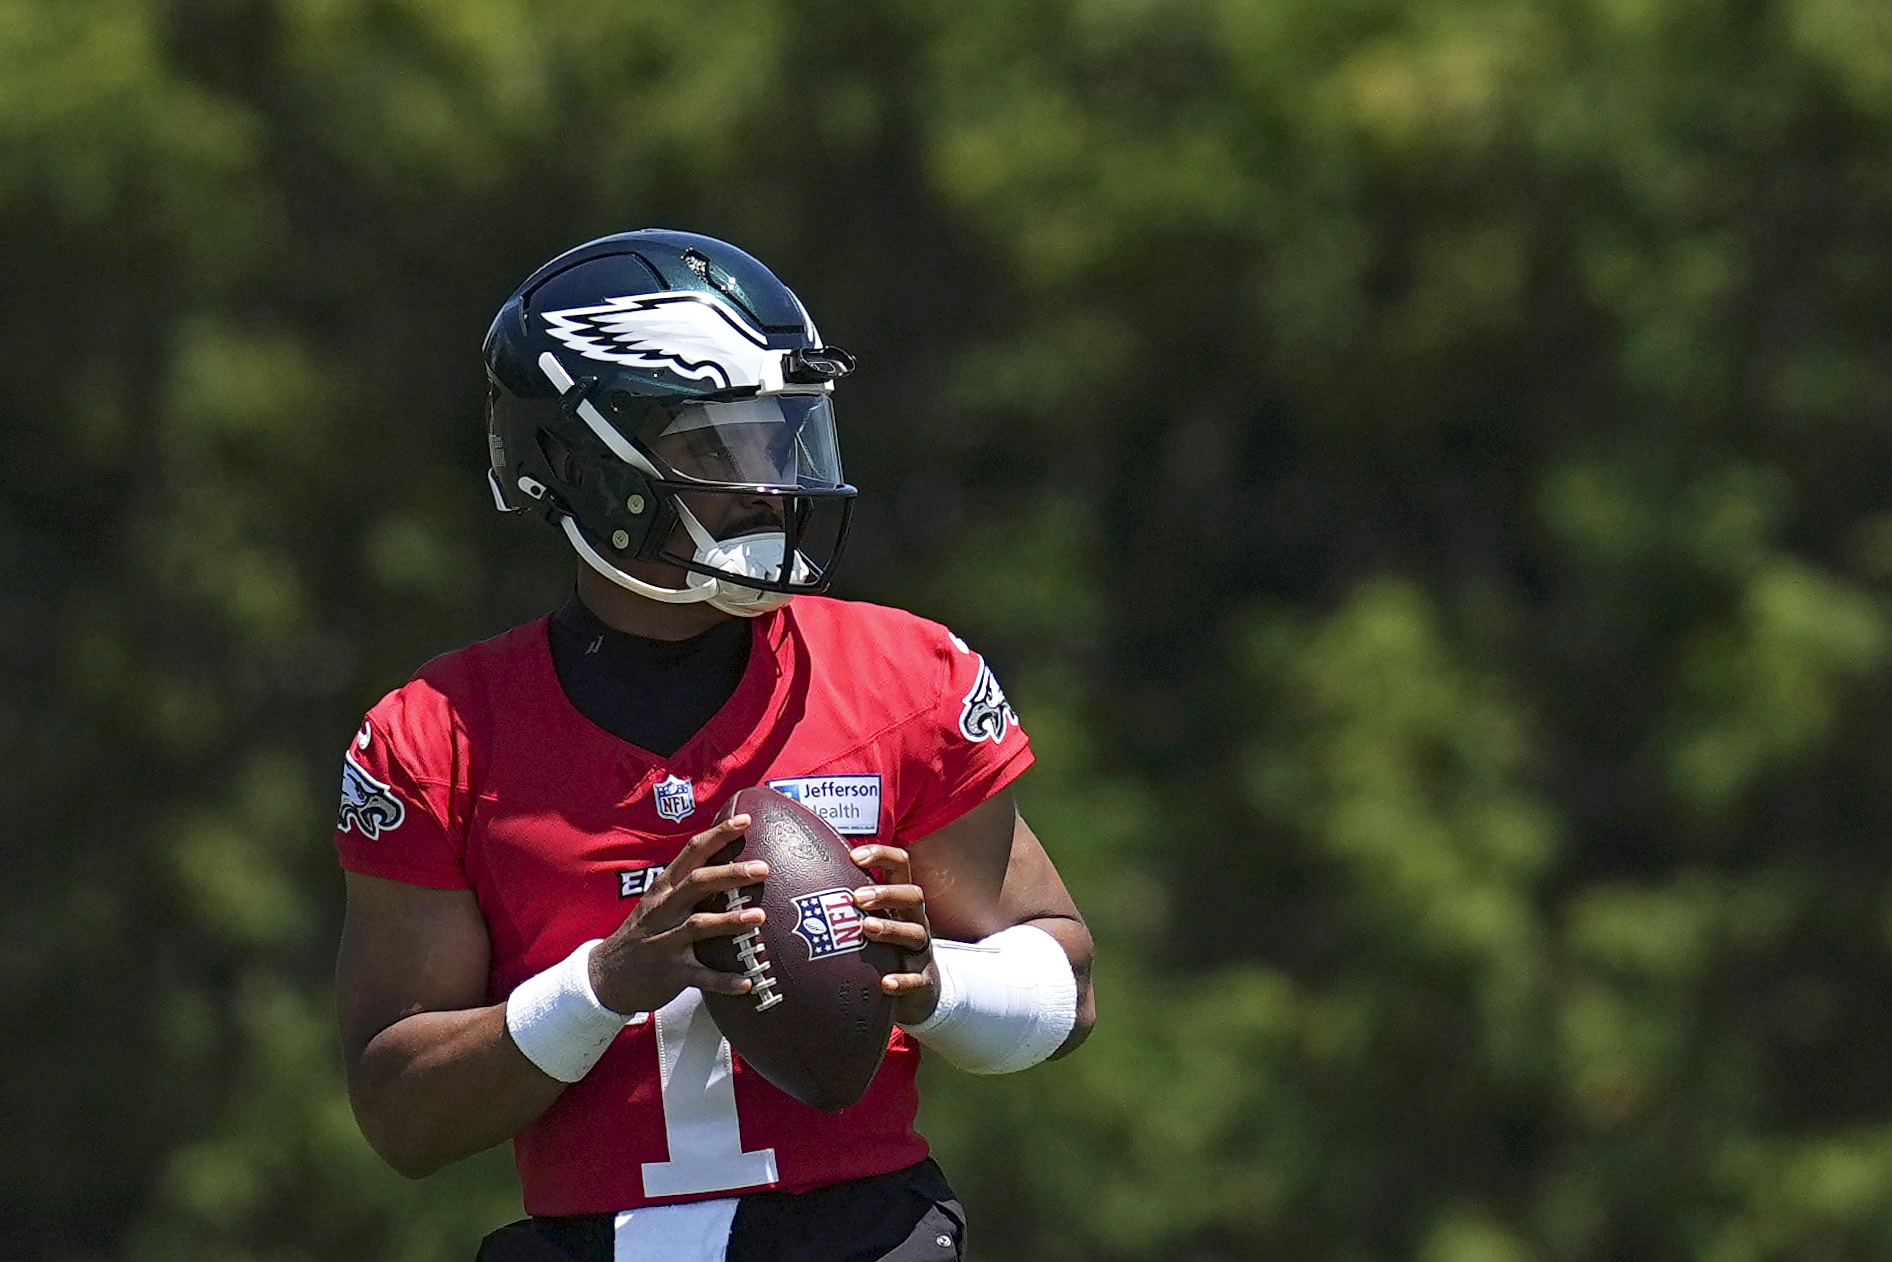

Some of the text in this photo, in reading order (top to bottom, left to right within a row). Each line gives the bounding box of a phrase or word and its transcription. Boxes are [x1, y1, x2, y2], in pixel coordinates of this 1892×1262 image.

[804, 781, 878, 798] Jefferson
[662, 796, 690, 814] NFL
[825, 895, 864, 945] NFL
